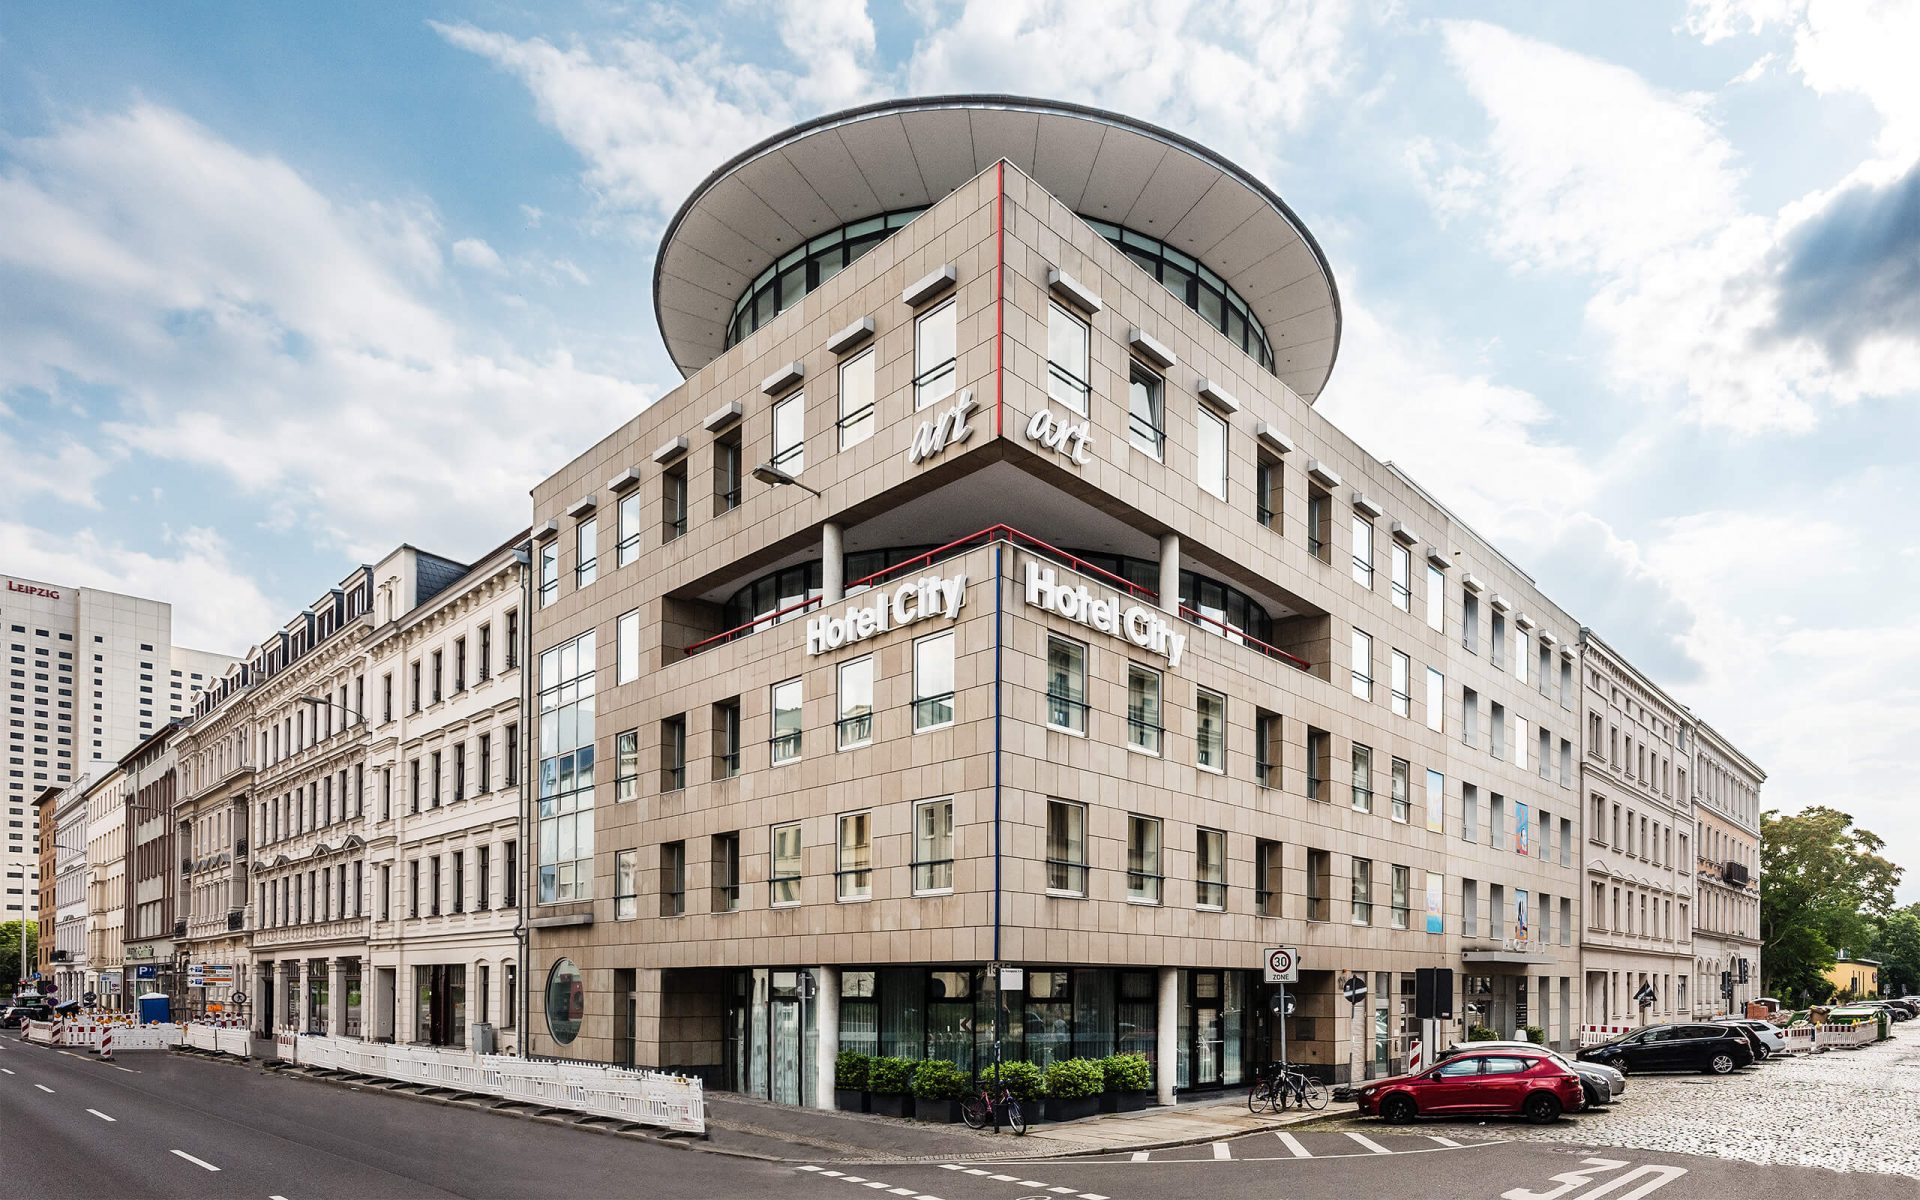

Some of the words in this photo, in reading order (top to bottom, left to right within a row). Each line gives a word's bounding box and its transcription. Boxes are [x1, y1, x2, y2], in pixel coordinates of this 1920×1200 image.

[908, 388, 980, 465] art
[1026, 408, 1096, 466] art
[806, 591, 889, 656] Hotel
[893, 573, 968, 625] City
[1025, 560, 1120, 636] Hotel
[1123, 605, 1186, 668] City
[1274, 956, 1287, 968] 30
